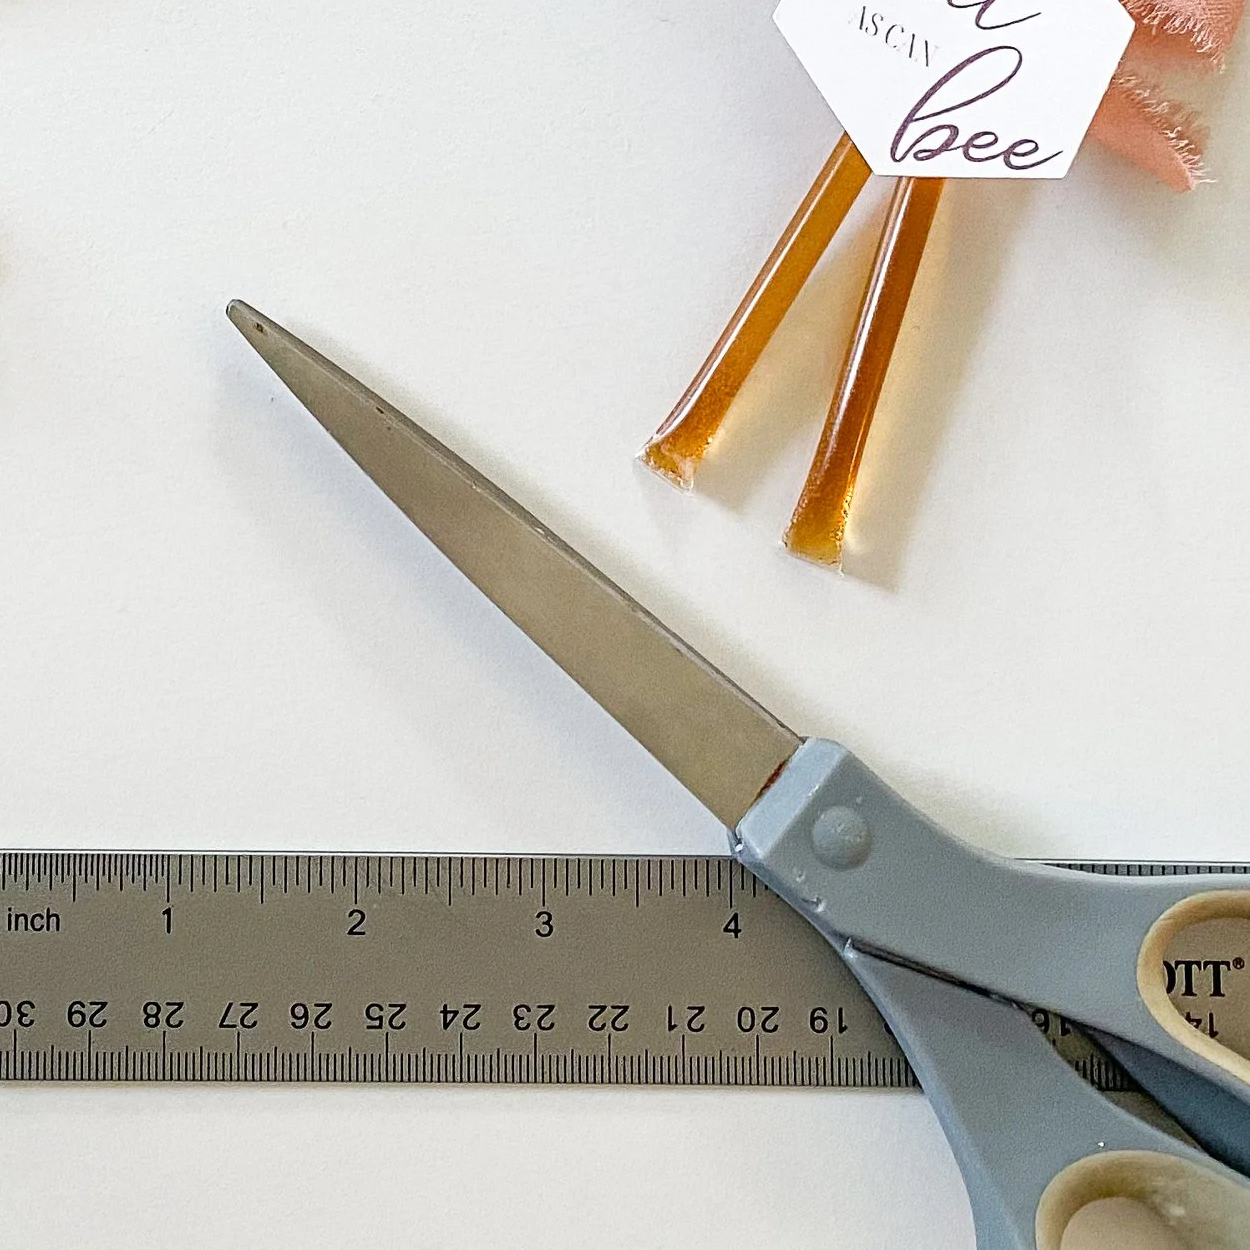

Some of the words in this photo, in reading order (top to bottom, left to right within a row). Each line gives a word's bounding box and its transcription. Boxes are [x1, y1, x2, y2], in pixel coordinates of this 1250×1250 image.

[890, 44, 1065, 171] bee
[7, 906, 61, 932] inch
[161, 906, 172, 935] 1
[347, 908, 366, 936] 2
[535, 910, 554, 938] 3
[723, 912, 742, 939] 4
[67, 1001, 108, 1027] 29
[143, 1002, 184, 1028] 28
[219, 1003, 258, 1029] 27
[291, 1003, 332, 1029] 26
[366, 1003, 406, 1030] 25
[440, 1004, 481, 1030] 24
[513, 1004, 555, 1030] 23
[588, 1005, 629, 1031] 22
[667, 1005, 706, 1032] 21
[738, 1007, 779, 1033] 20
[810, 1007, 848, 1034] 19
